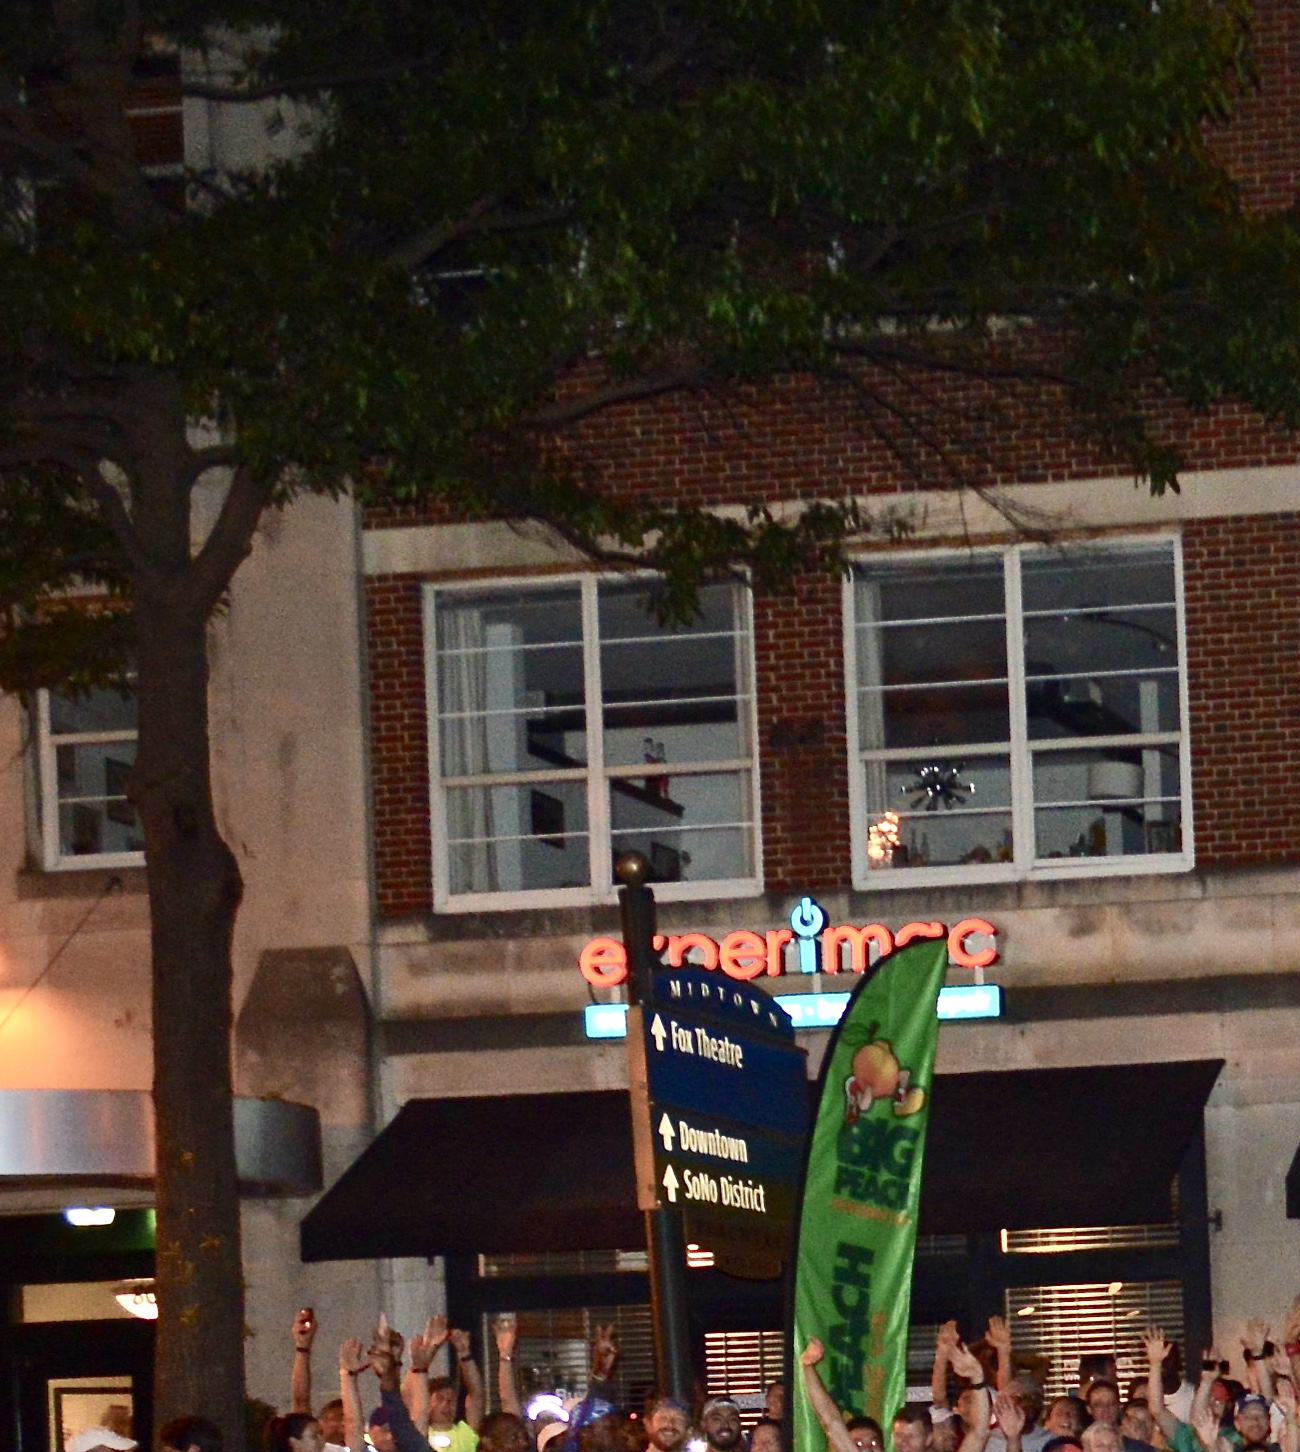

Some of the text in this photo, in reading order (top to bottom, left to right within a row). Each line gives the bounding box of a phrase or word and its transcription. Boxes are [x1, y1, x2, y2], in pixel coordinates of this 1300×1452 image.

[579, 896, 999, 986] eperimc
[669, 980, 778, 1028] MIDTOWN
[670, 1020, 694, 1055] Fox
[694, 1027, 744, 1069] Theatre
[678, 1120, 748, 1164] Downtown
[837, 1116, 921, 1179] BIG
[683, 1169, 766, 1213] SoNo District
